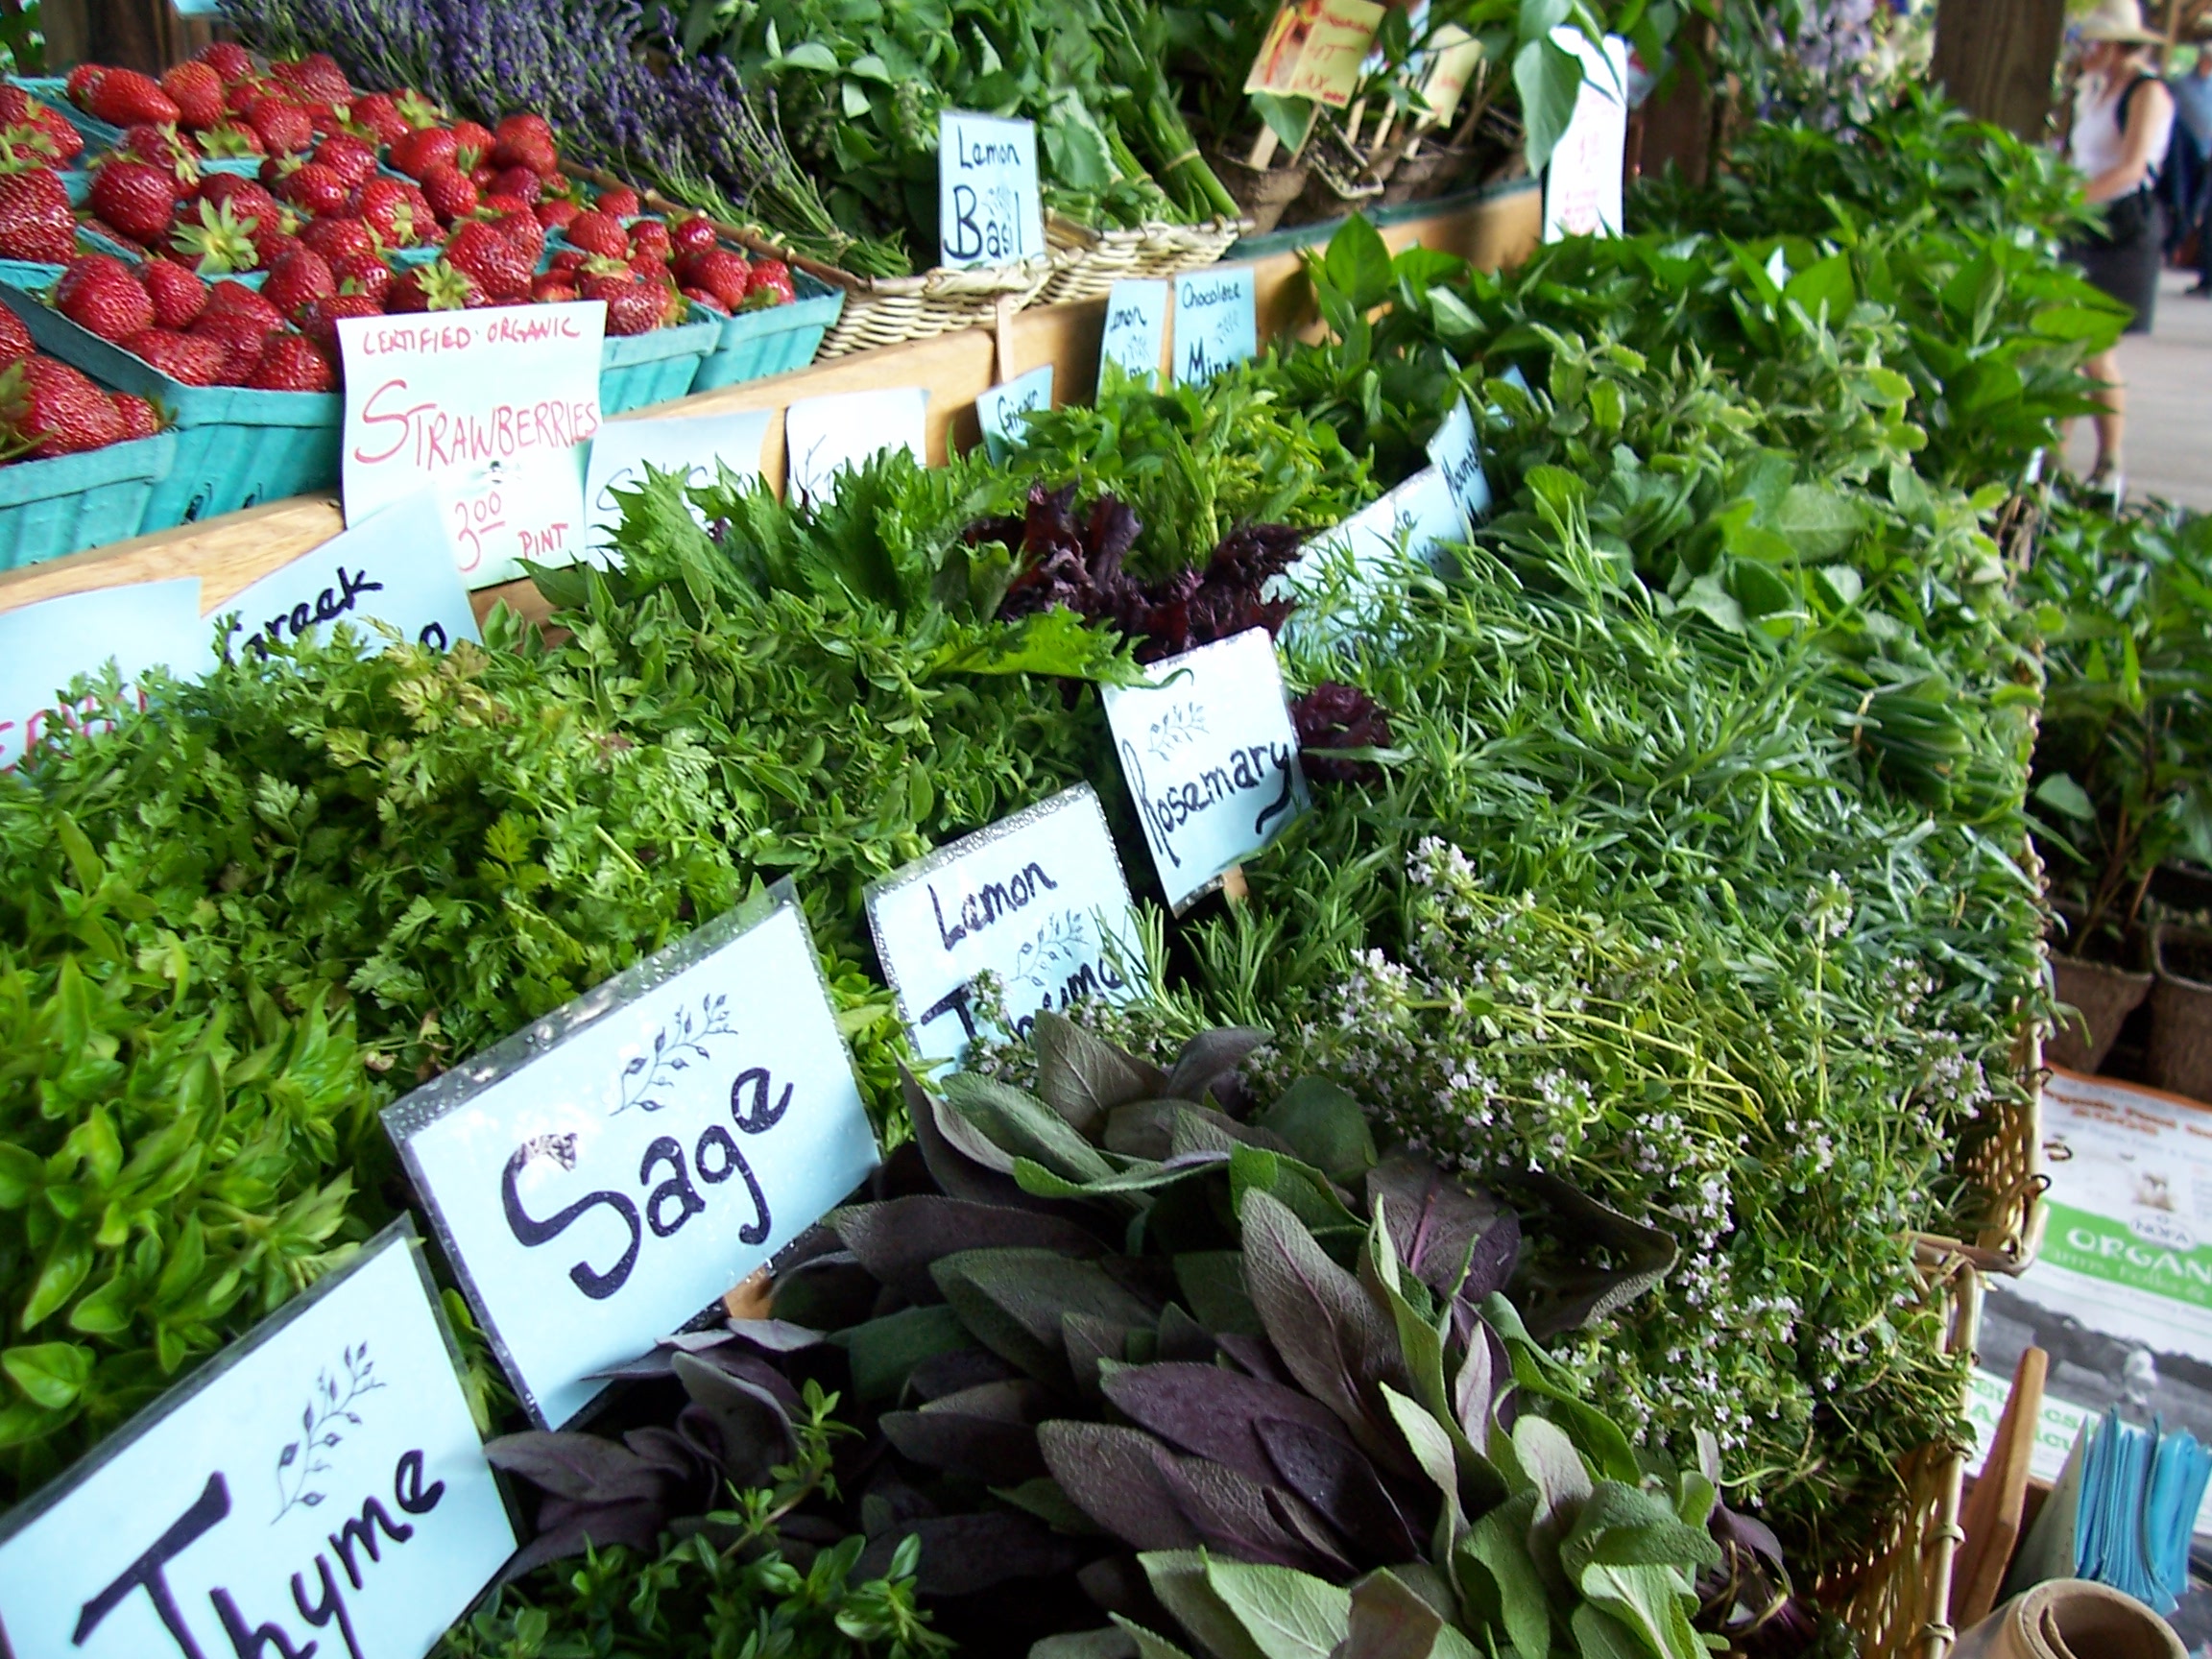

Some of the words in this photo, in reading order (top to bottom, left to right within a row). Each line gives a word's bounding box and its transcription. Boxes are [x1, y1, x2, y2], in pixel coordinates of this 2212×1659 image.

[956, 124, 1022, 170] Lemon
[943, 183, 1023, 261] Basil
[363, 326, 471, 355] CERTIFIED
[487, 316, 581, 344] ORGANIC
[1182, 278, 1241, 309] Chocolate
[353, 378, 599, 471] STRAWBERRIES
[517, 522, 569, 560] PINT
[1120, 738, 1291, 869] Rosemary
[926, 860, 1058, 952] Lemon
[500, 1067, 795, 1301] Sage
[71, 1449, 446, 1659] Thyme
